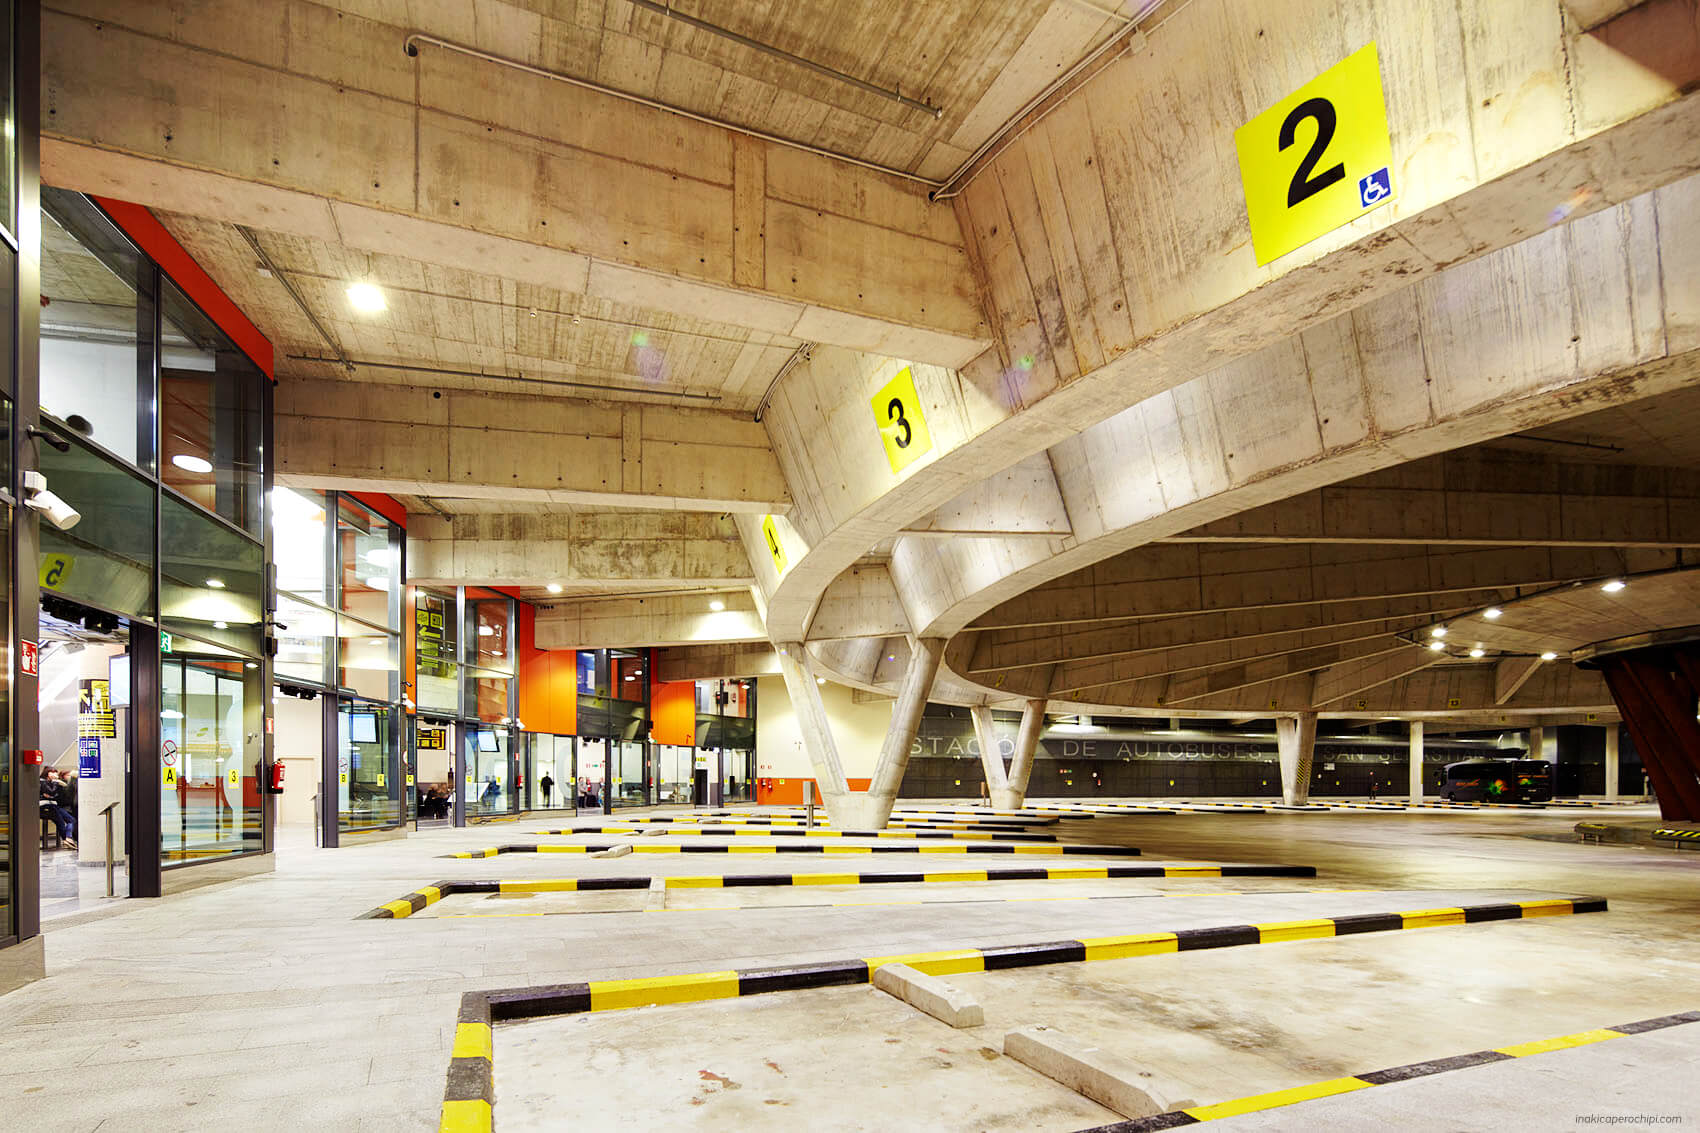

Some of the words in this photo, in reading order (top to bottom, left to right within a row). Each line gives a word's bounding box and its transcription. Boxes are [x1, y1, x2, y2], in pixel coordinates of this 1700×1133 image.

[1278, 97, 1346, 209] 2
[888, 398, 912, 449] 3
[910, 734, 1016, 757] STACÓ
[1063, 741, 1097, 757] DE
[1116, 742, 1262, 760] AUTOBUSES
[1322, 746, 1364, 761] SAN
[166, 769, 174, 782] A
